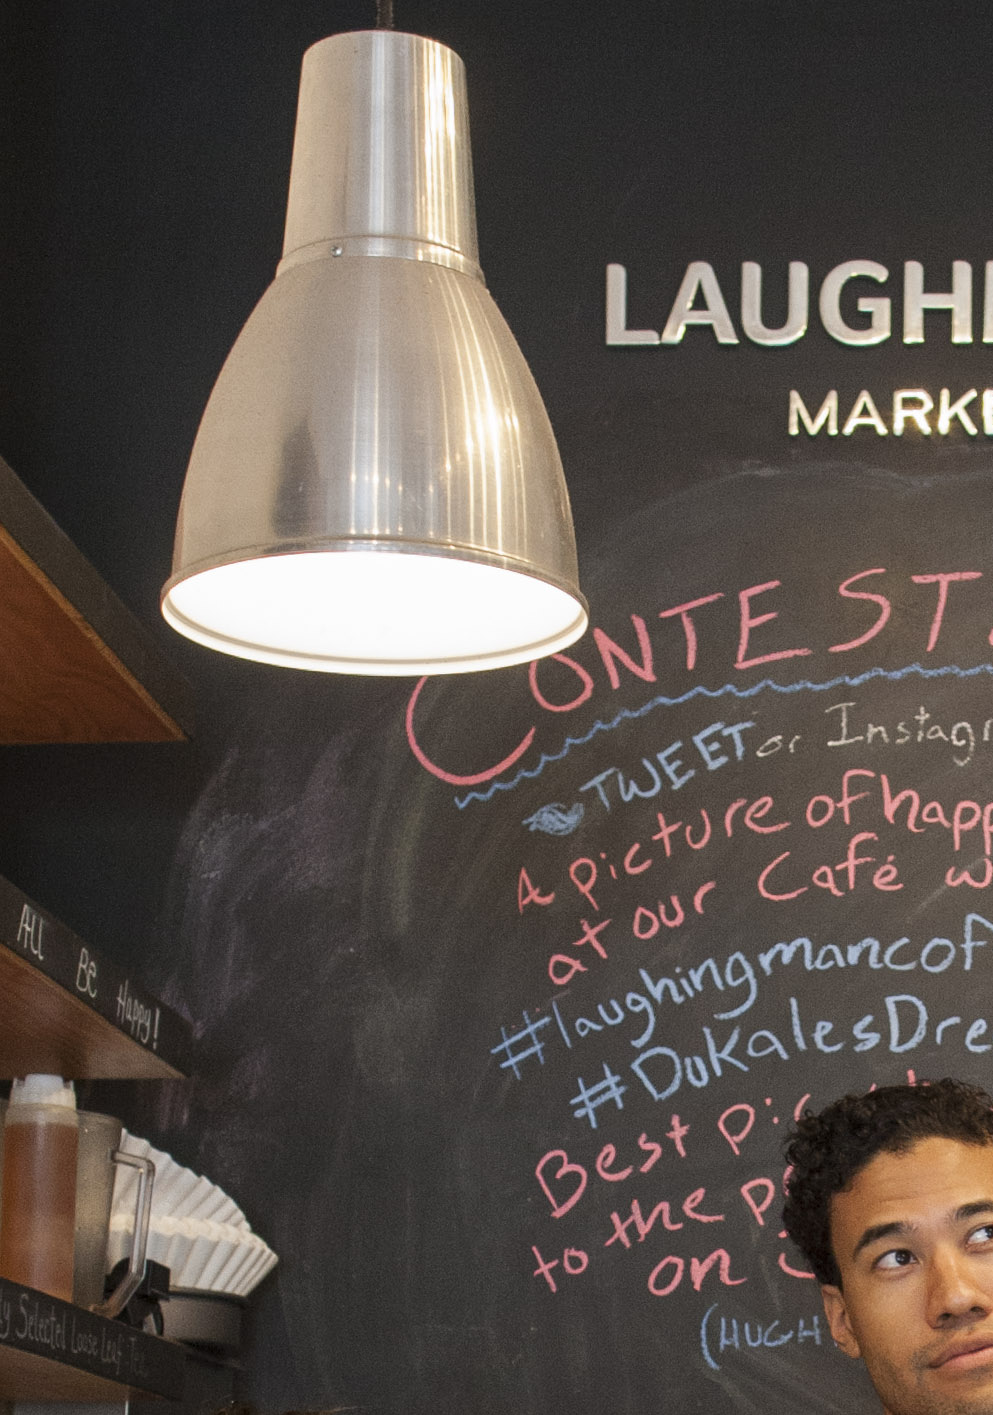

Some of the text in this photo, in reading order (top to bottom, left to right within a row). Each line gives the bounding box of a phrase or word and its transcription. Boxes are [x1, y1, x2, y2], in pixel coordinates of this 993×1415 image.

[580, 720, 757, 812] TWEET
[755, 727, 800, 757] or
[569, 795, 791, 907] picture
[806, 769, 877, 826] of
[547, 919, 611, 984] at
[633, 881, 716, 940] our
[758, 832, 902, 900] Café
[76, 947, 97, 998] Be
[536, 1114, 689, 1218] Best
[532, 1245, 588, 1293] to
[605, 1187, 725, 1248] the
[648, 1248, 747, 1296] on
